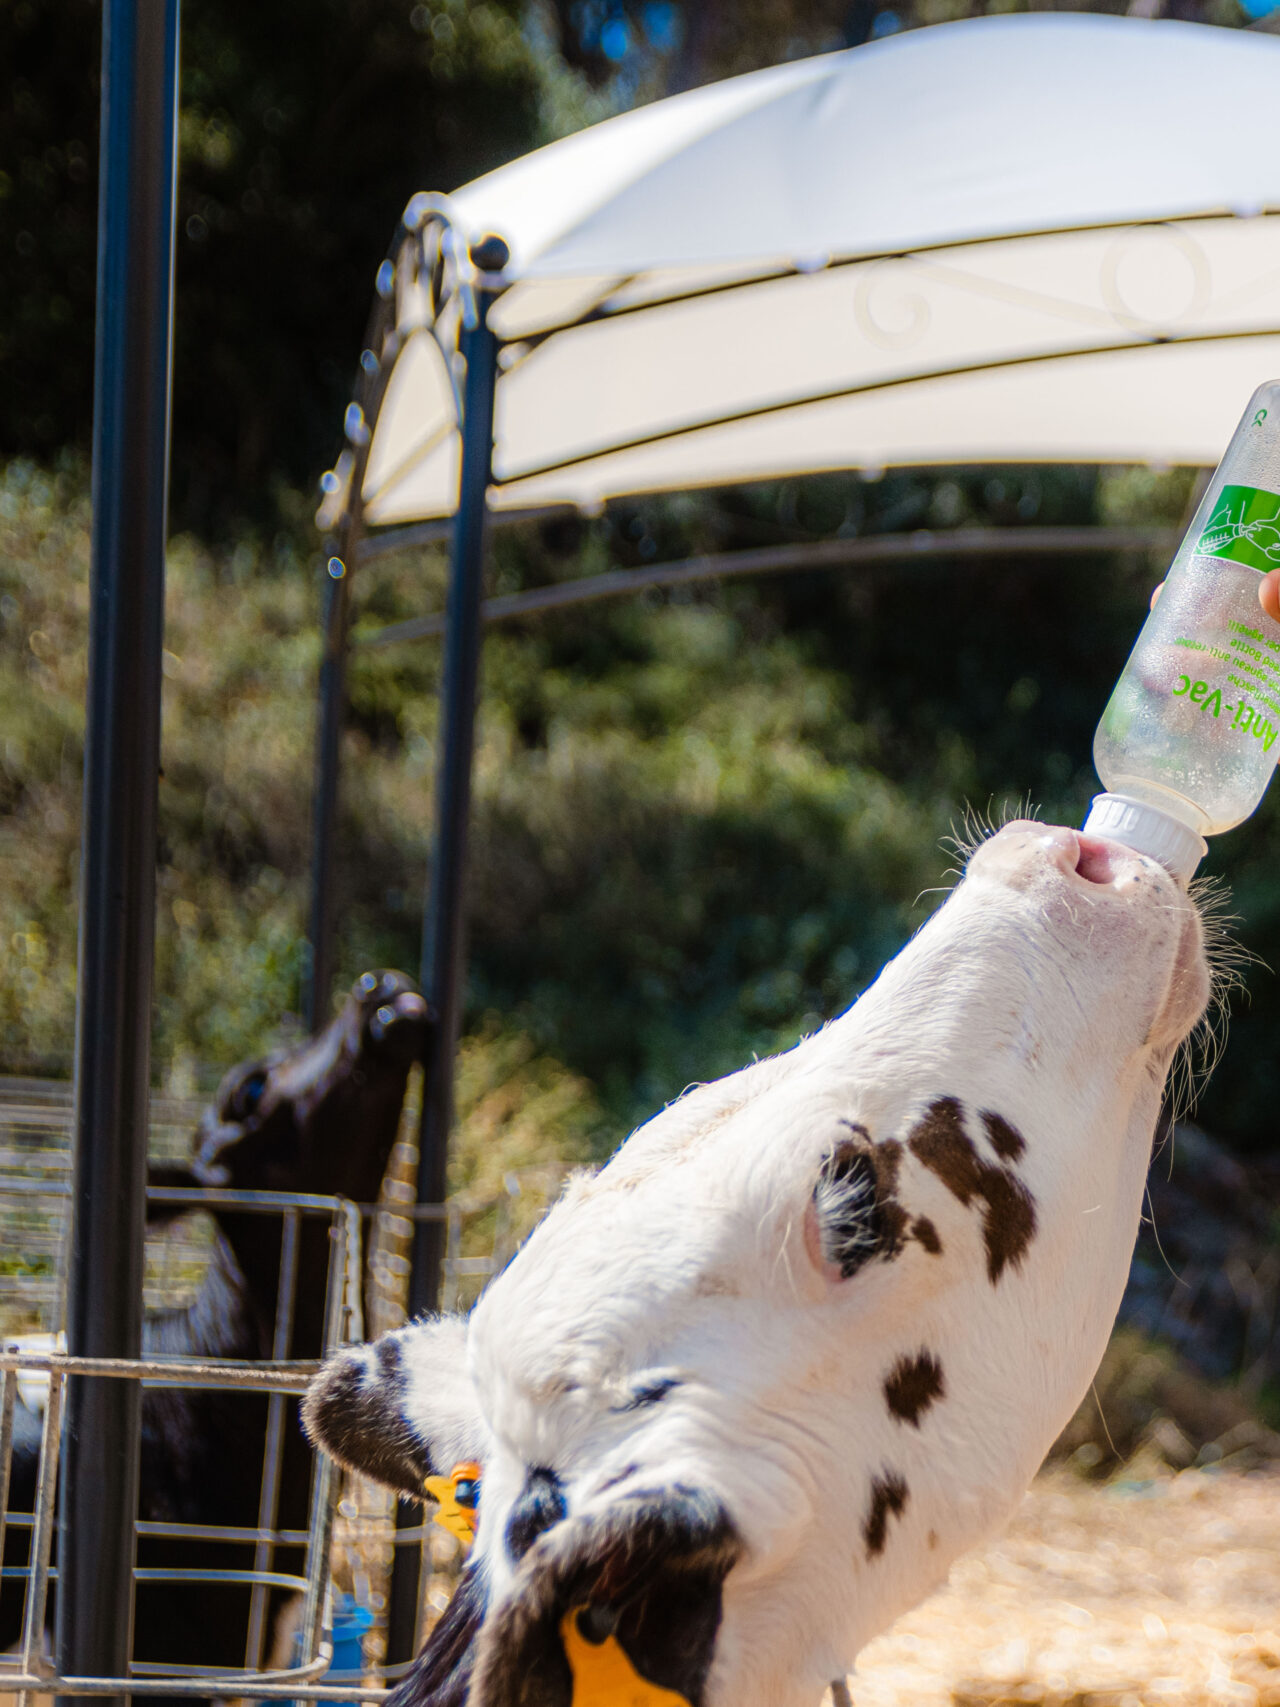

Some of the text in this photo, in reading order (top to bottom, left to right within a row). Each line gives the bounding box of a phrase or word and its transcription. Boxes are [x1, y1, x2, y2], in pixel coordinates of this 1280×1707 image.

[1230, 638, 1262, 662] Bottle
[1233, 657, 1268, 682] agneau
[1172, 674, 1279, 753] Anti-Vac
